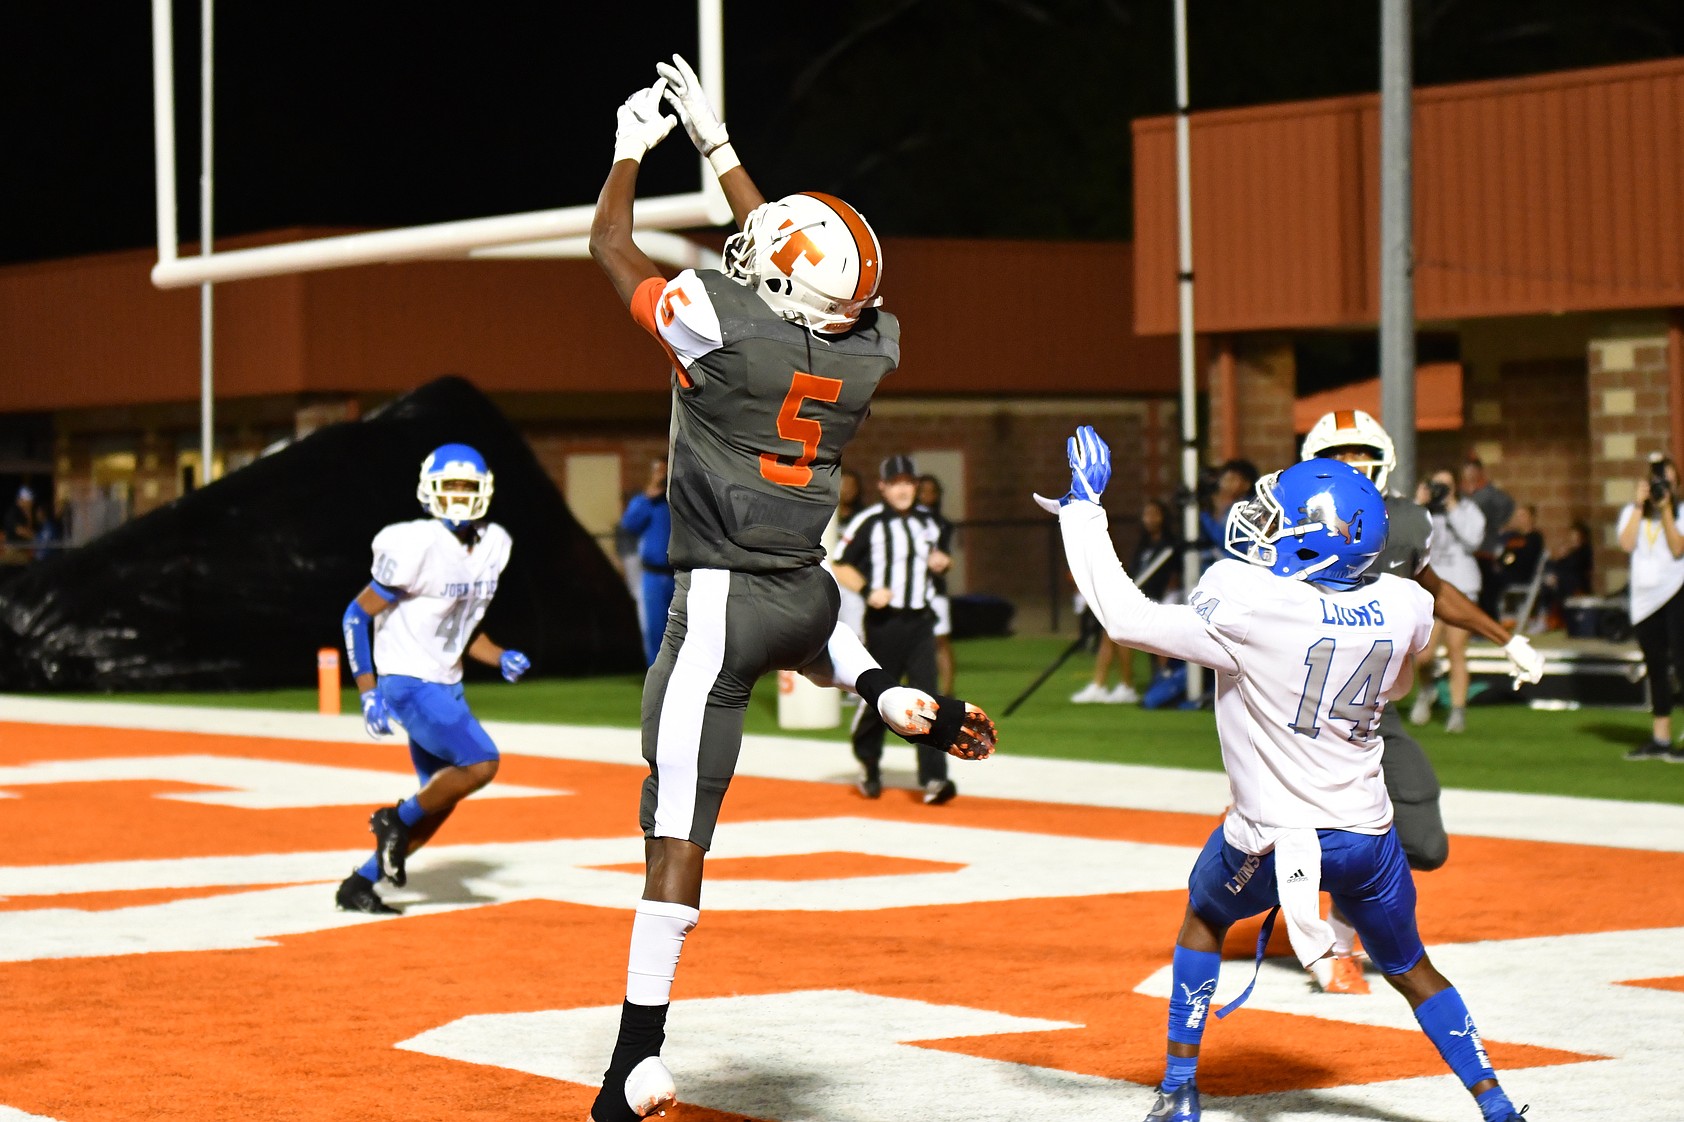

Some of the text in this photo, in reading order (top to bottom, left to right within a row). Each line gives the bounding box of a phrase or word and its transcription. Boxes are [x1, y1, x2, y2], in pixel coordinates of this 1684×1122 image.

[661, 286, 692, 328] 5
[759, 371, 843, 487] 5
[440, 582, 469, 598] JOHN
[1319, 597, 1386, 628] LIONS
[1287, 636, 1394, 742] 14
[1224, 853, 1261, 897] LIONS
